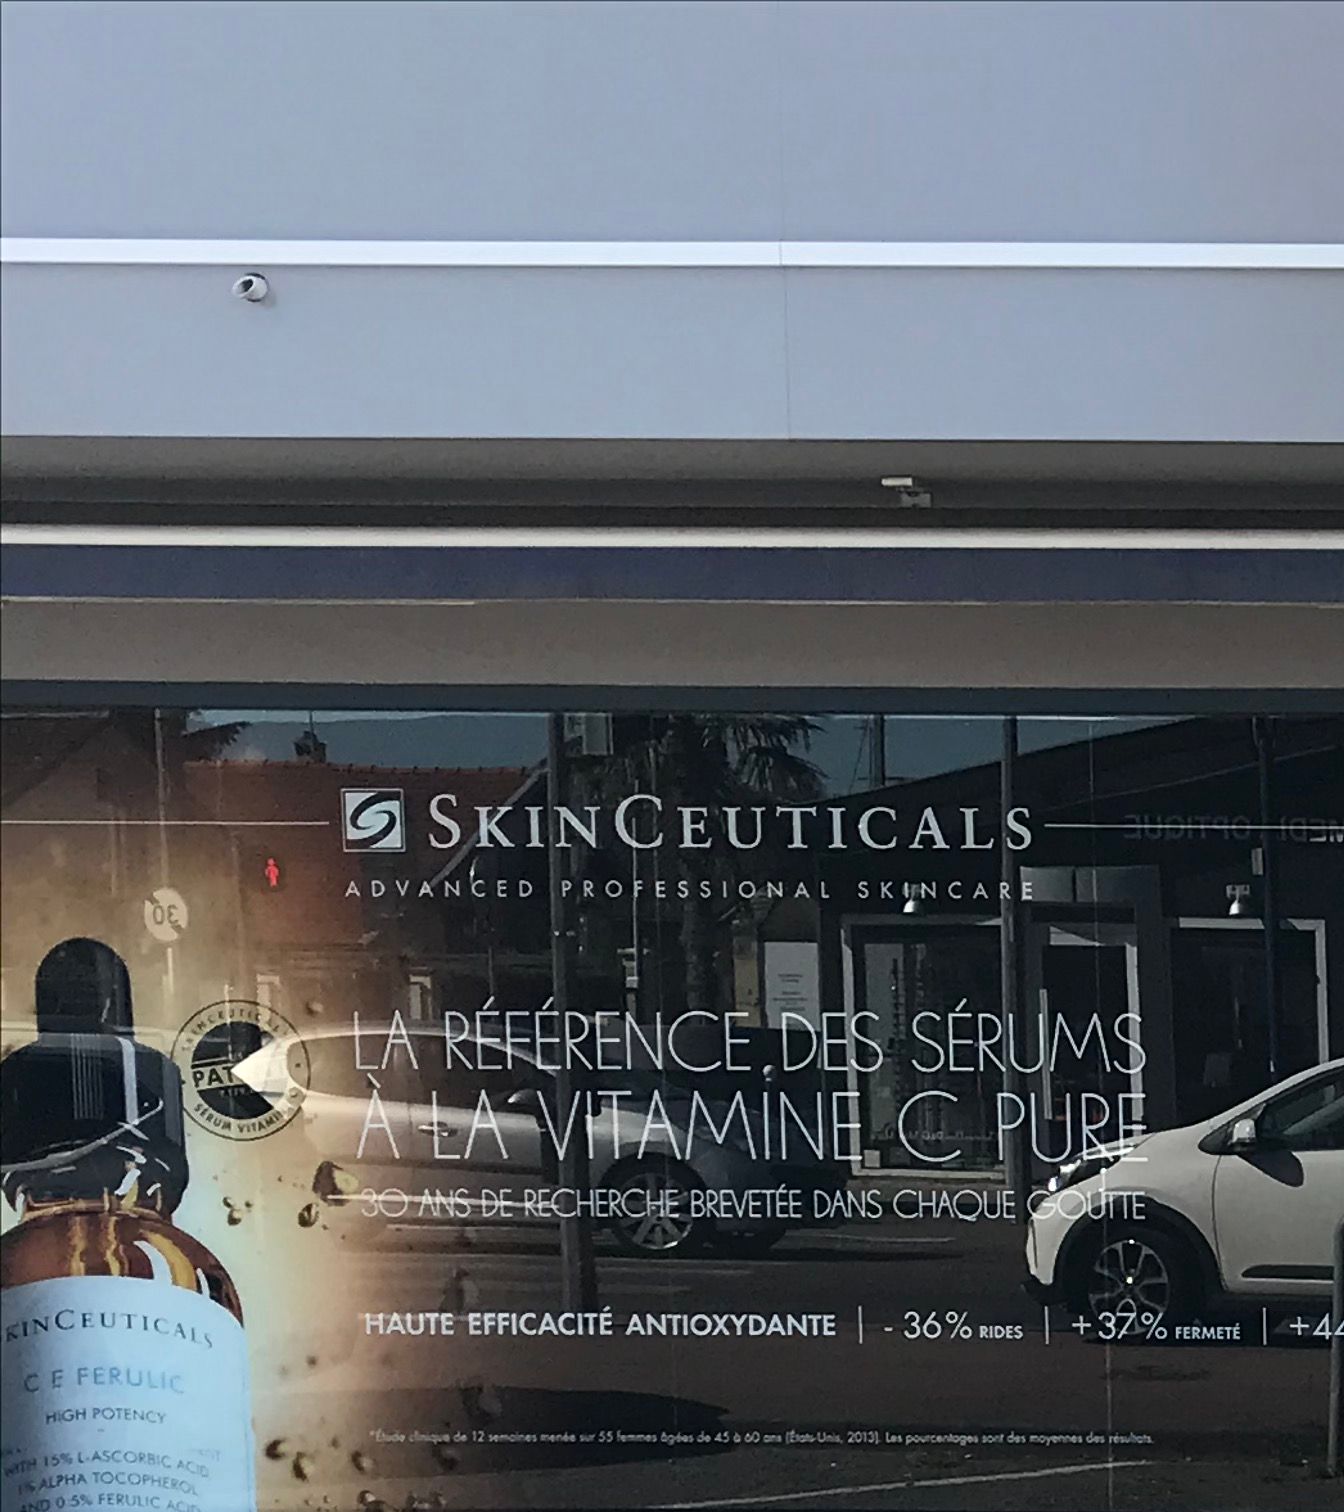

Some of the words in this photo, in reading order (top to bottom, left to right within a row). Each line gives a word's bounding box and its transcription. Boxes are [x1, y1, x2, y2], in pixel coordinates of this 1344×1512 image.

[345, 880, 533, 898] ADVANCED
[561, 880, 830, 899] PROFESSIONAL
[858, 881, 1033, 900] SKINCARE
[353, 1010, 418, 1071] LA
[444, 995, 751, 1072] RÉFÉRENCE
[781, 1012, 884, 1073] DES
[911, 997, 1147, 1074] SÉRUMS
[357, 1073, 400, 1160] À
[431, 1089, 509, 1160] LA
[536, 1089, 862, 1161] VITAMINE
[898, 1090, 962, 1162] C
[997, 1091, 1148, 1163] PURE
[361, 1188, 408, 1218] 30
[418, 1188, 471, 1218] ANS
[481, 1189, 514, 1218] DE
[524, 1189, 680, 1218] RECHERCHE
[690, 1184, 802, 1219] BREVETÉE
[814, 1190, 883, 1219] DANS
[893, 1189, 1015, 1221] CHAQUE
[1027, 1190, 1146, 1220] GOUTTE
[5, 1308, 213, 1348] KINCEUTICALS
[364, 1312, 454, 1336] HAUTE
[468, 1305, 613, 1336] EFFICACITÉ
[625, 1313, 836, 1337] ANTIOXYDANTE
[979, 1324, 1023, 1340] RIDES
[1175, 1321, 1241, 1340] FERMETÉ
[24, 1373, 40, 1393] C
[77, 1367, 185, 1394] FERULIC
[45, 1408, 87, 1425] HIGH
[92, 1407, 167, 1424] POTENCY
[176, 1460, 210, 1478] ACID
[38, 1474, 87, 1490] ALPHA
[92, 1471, 199, 1497] TOCOPHEROL
[98, 1493, 161, 1508] FERULIC
